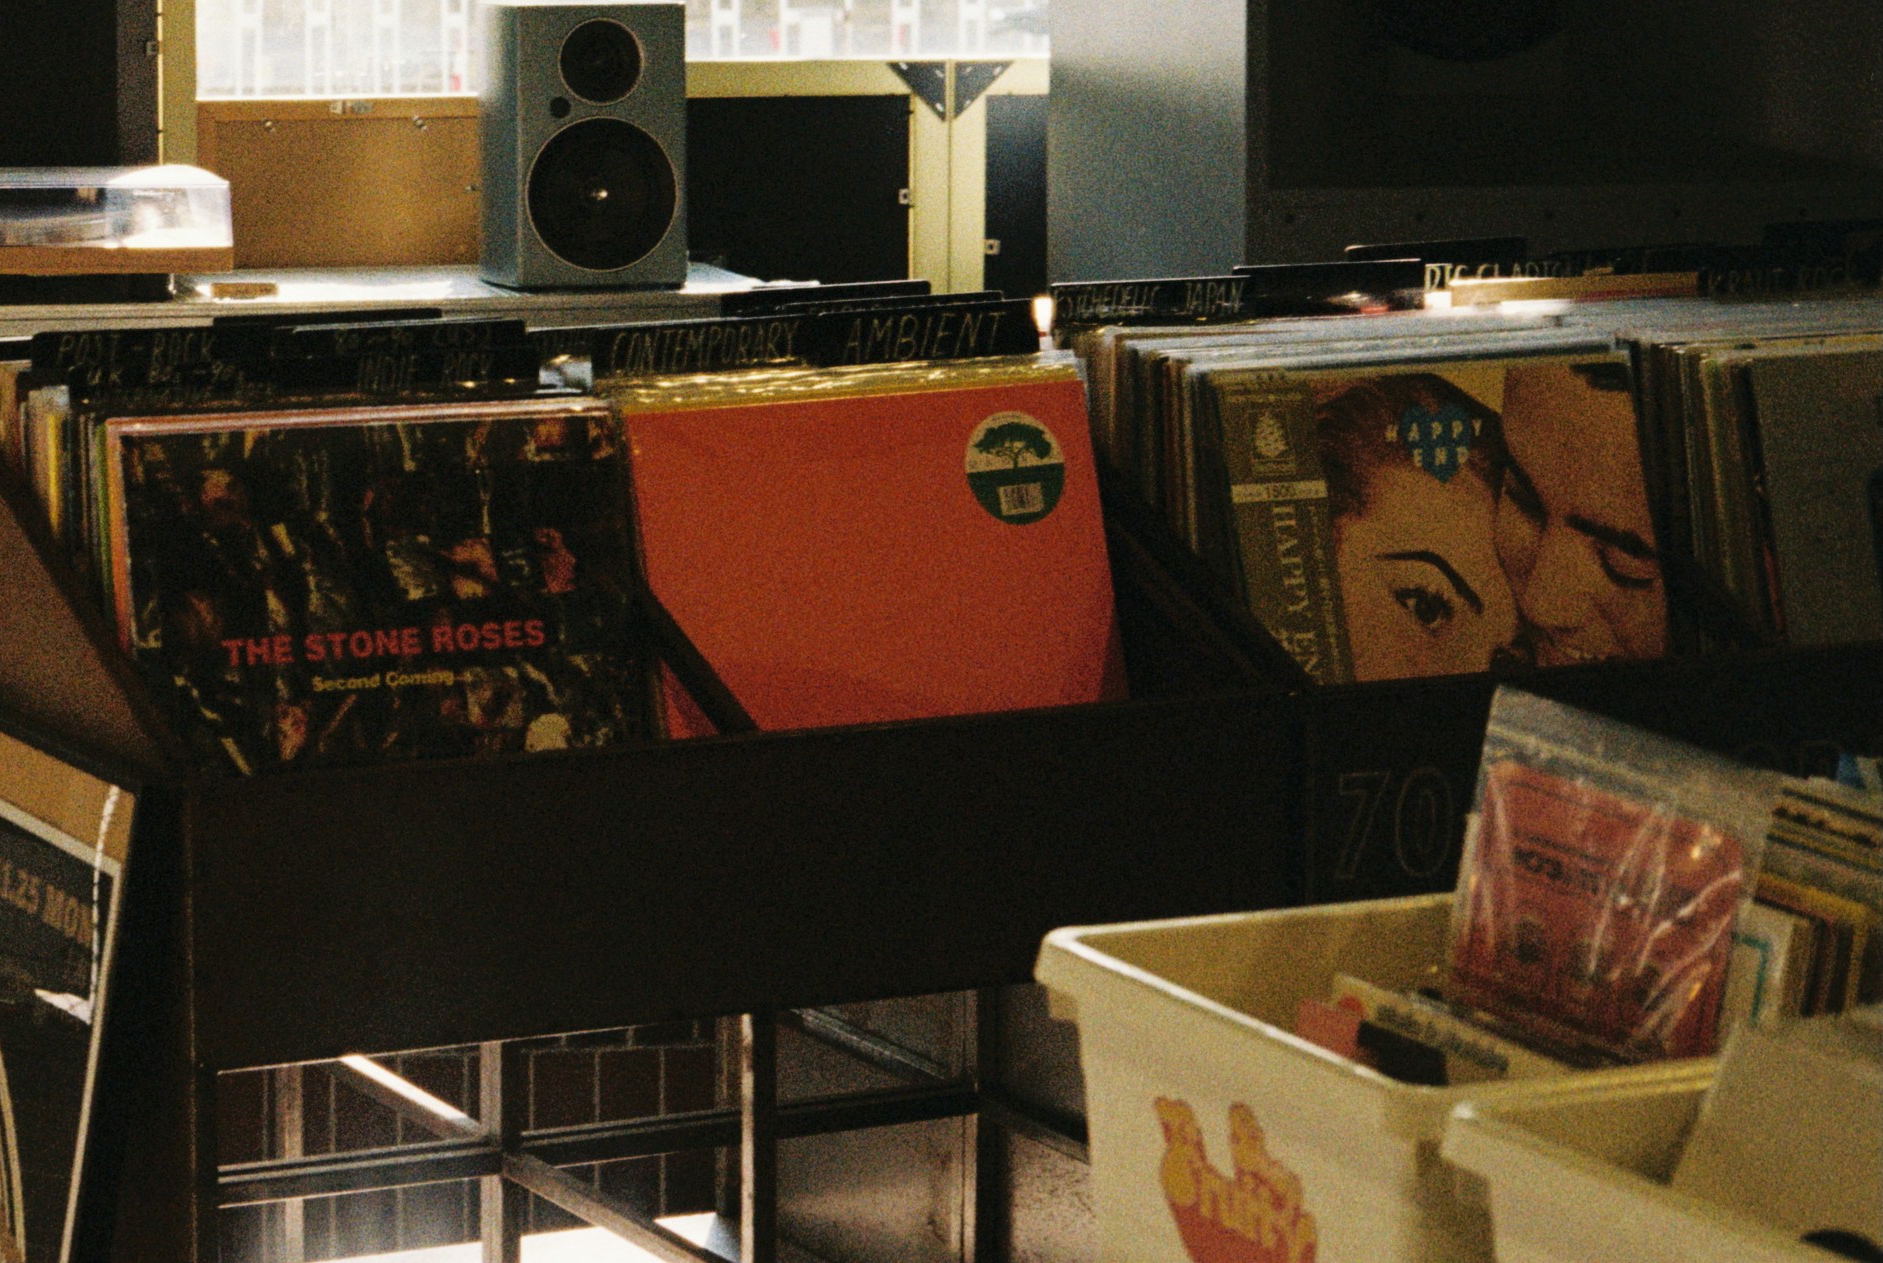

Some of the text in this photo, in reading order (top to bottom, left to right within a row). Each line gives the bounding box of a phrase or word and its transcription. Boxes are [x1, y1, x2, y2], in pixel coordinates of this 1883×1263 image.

[1170, 281, 1245, 317] JAPAN
[610, 320, 800, 372] CONTEMPORARY
[842, 310, 1006, 364] AMBIENT
[1384, 418, 1482, 443] HAPPY
[1412, 445, 1469, 468] END
[1271, 504, 1310, 613] HAPPY
[220, 618, 546, 667] THE STONE ROSES
[310, 669, 456, 693] Second Coming
